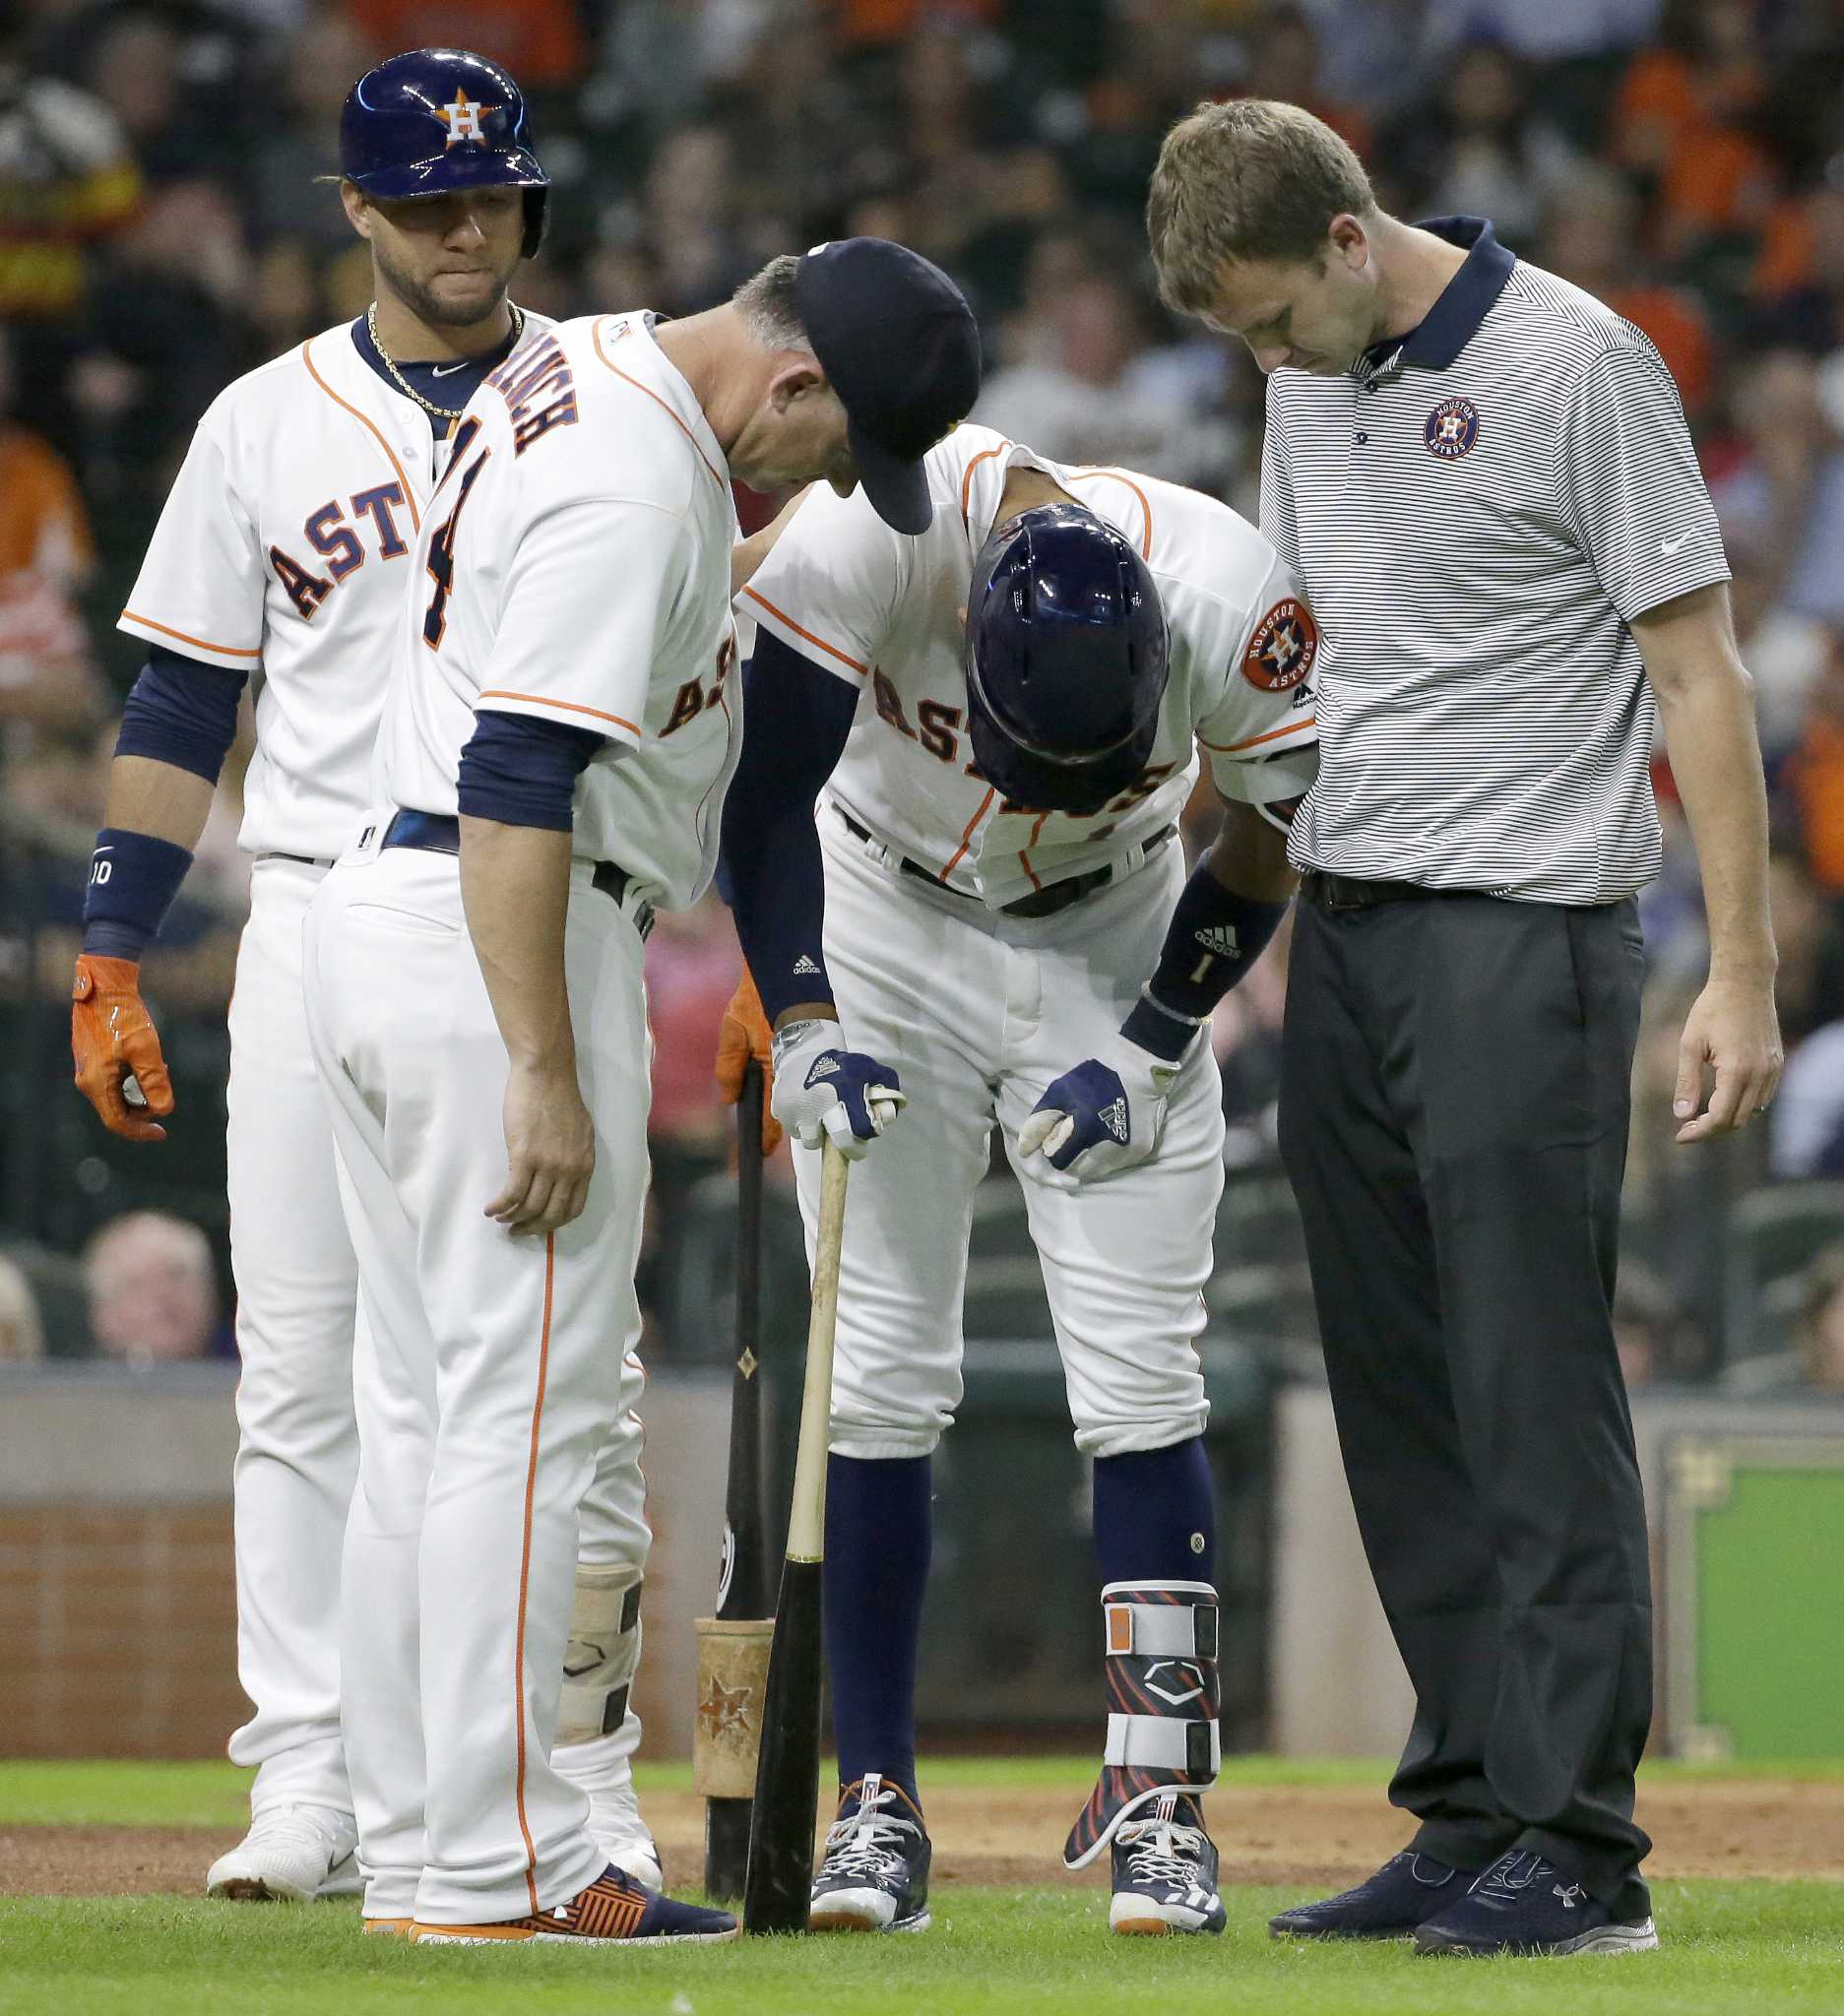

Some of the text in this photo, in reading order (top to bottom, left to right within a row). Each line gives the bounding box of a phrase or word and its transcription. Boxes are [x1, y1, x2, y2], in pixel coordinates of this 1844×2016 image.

[1436, 401, 1475, 419] HOUSTON
[1429, 438, 1466, 455] ASTROS
[1248, 603, 1296, 660] HOUSTON
[1268, 640, 1314, 688] ASTROS
[1194, 930, 1242, 960] adidas
[793, 965, 821, 975] adidas
